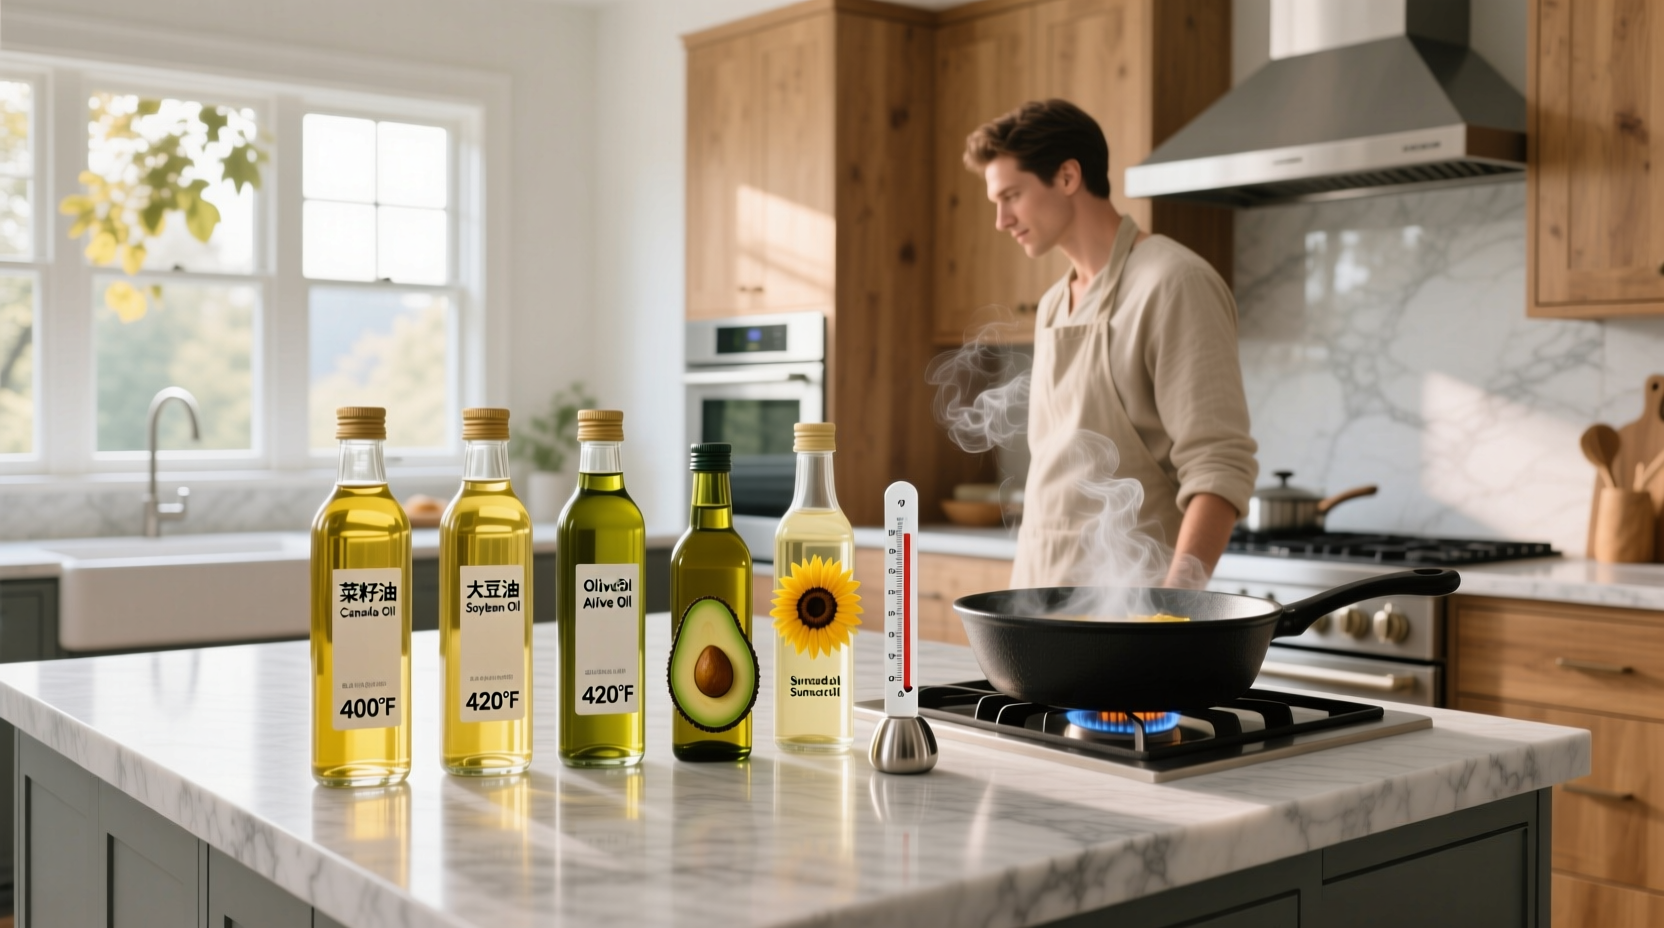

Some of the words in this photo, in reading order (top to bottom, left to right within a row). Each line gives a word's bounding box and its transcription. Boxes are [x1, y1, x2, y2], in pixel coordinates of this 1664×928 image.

[339, 582, 397, 603] 菜籽油
[466, 580, 519, 598] 大豆油
[507, 600, 520, 612] Oil
[466, 691, 519, 711] 420°F
[582, 684, 633, 704] 420°F
[340, 697, 396, 719] 400°F
